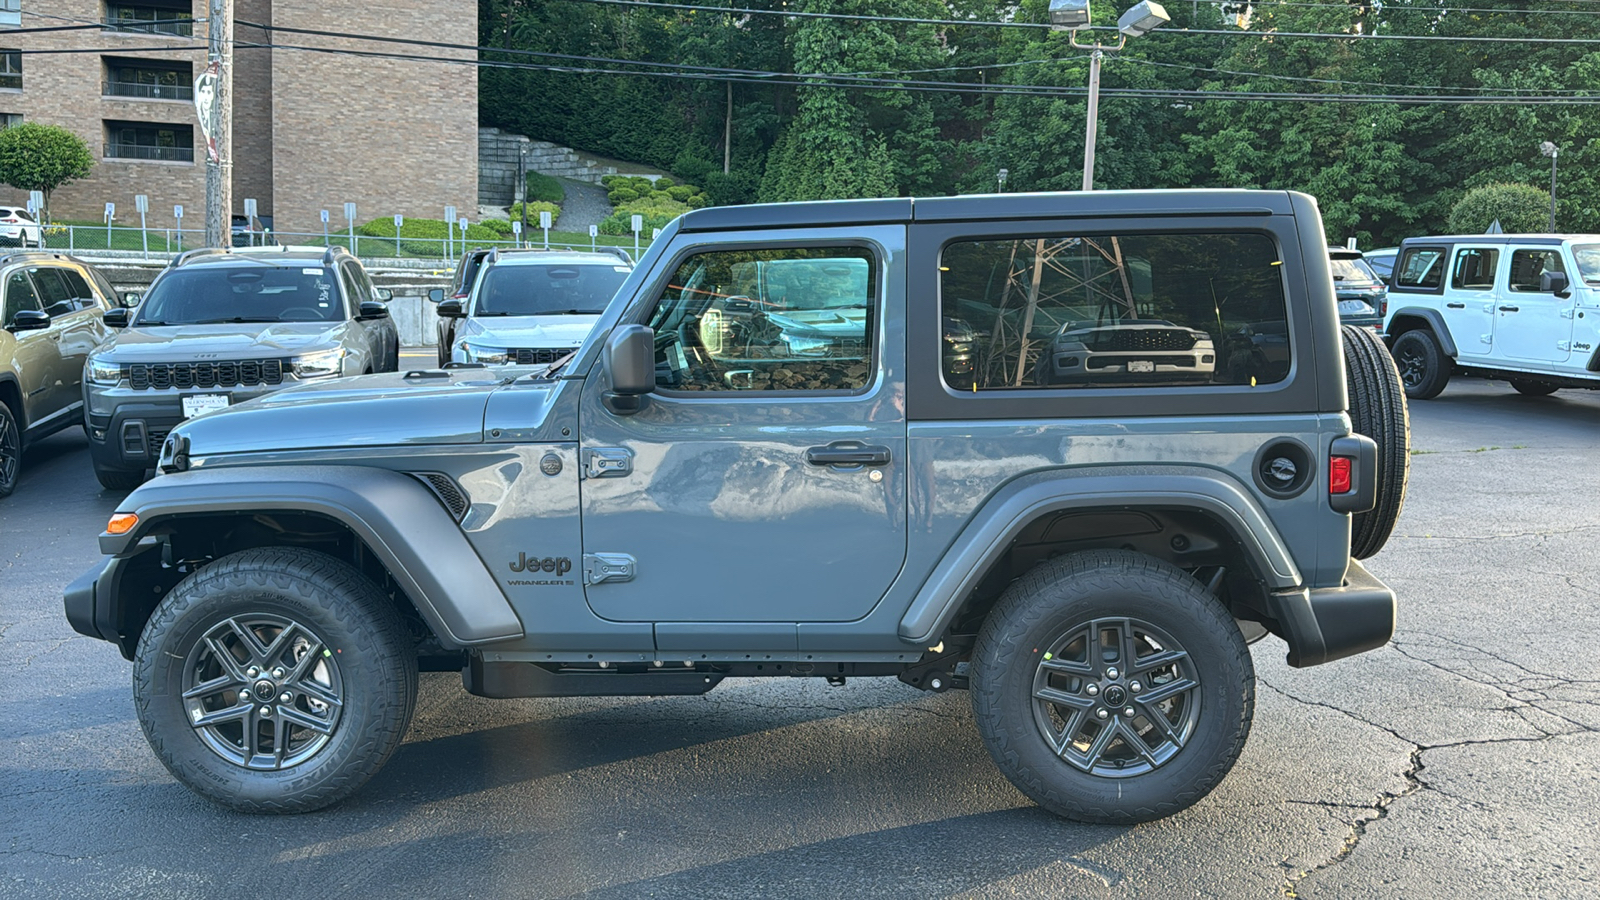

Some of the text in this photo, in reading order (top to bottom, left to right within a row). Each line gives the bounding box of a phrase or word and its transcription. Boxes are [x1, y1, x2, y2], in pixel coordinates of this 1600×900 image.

[1573, 341, 1591, 350] Jeep
[509, 551, 572, 577] Jeep
[260, 591, 312, 612] All-Weather
